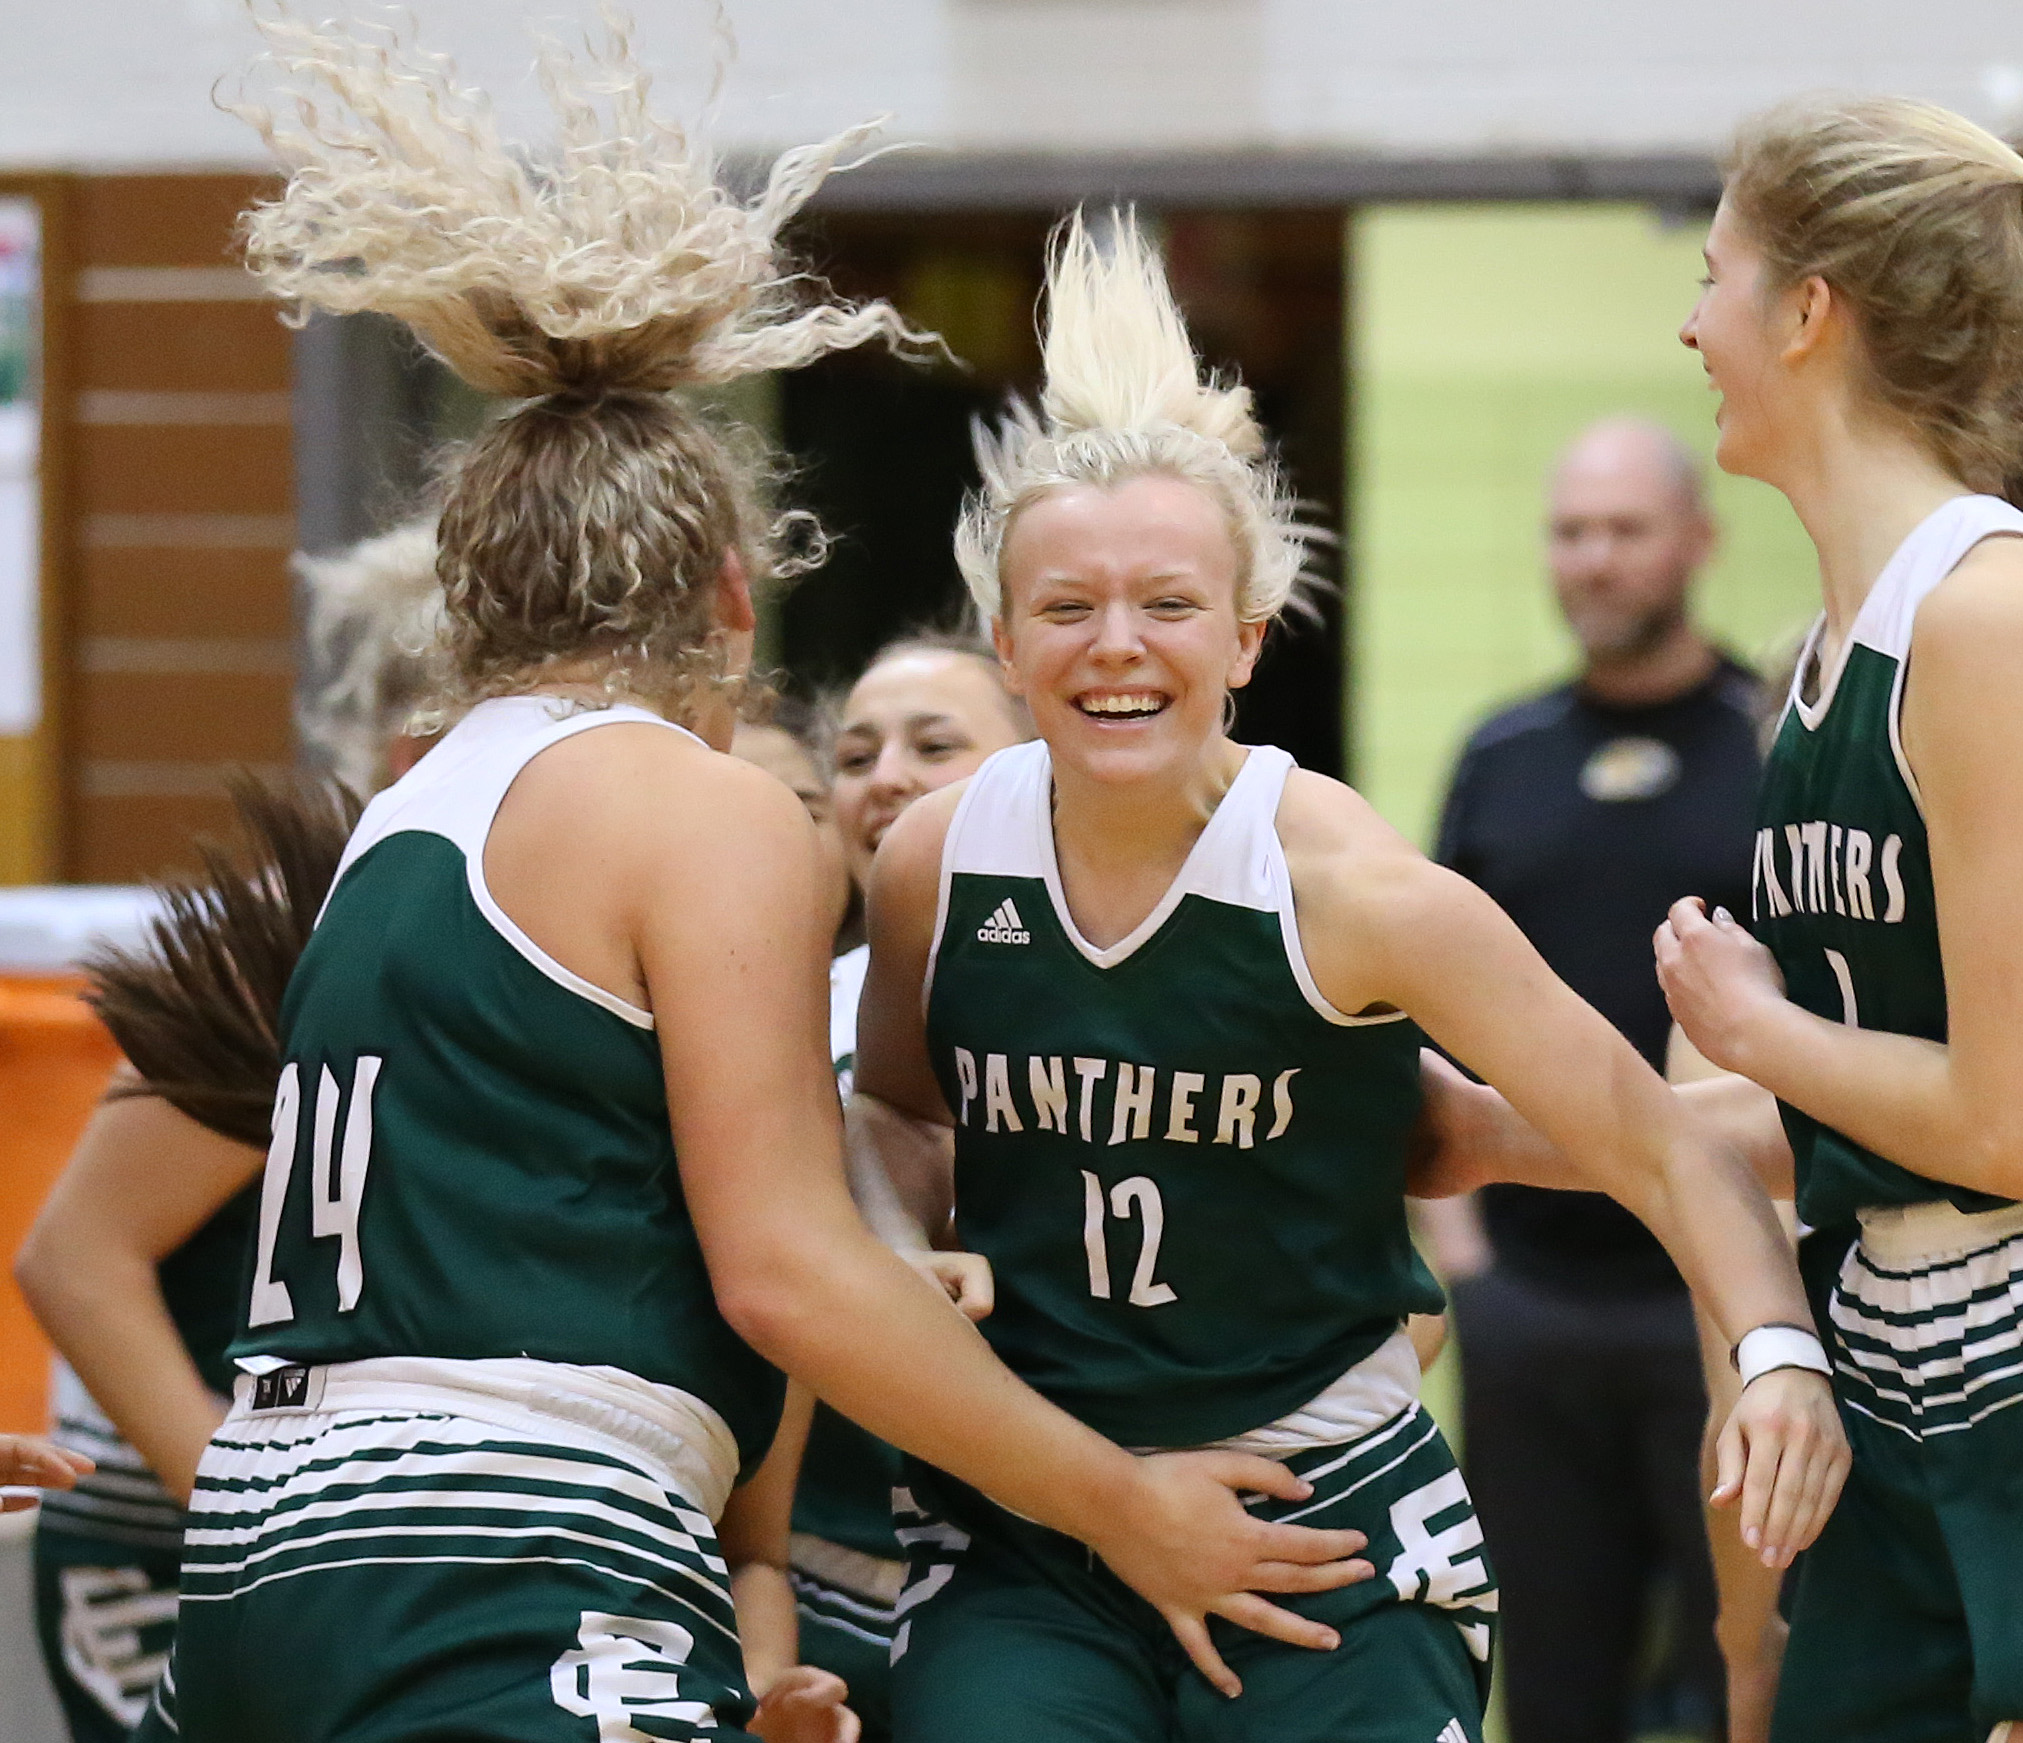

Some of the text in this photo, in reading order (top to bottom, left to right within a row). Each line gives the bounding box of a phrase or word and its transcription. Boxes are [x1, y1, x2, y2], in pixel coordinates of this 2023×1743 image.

[977, 927, 1031, 945] adidas
[954, 1045, 1302, 1150] PANTHERS
[248, 1055, 383, 1329] 24
[1080, 1169, 1178, 1308] 12
